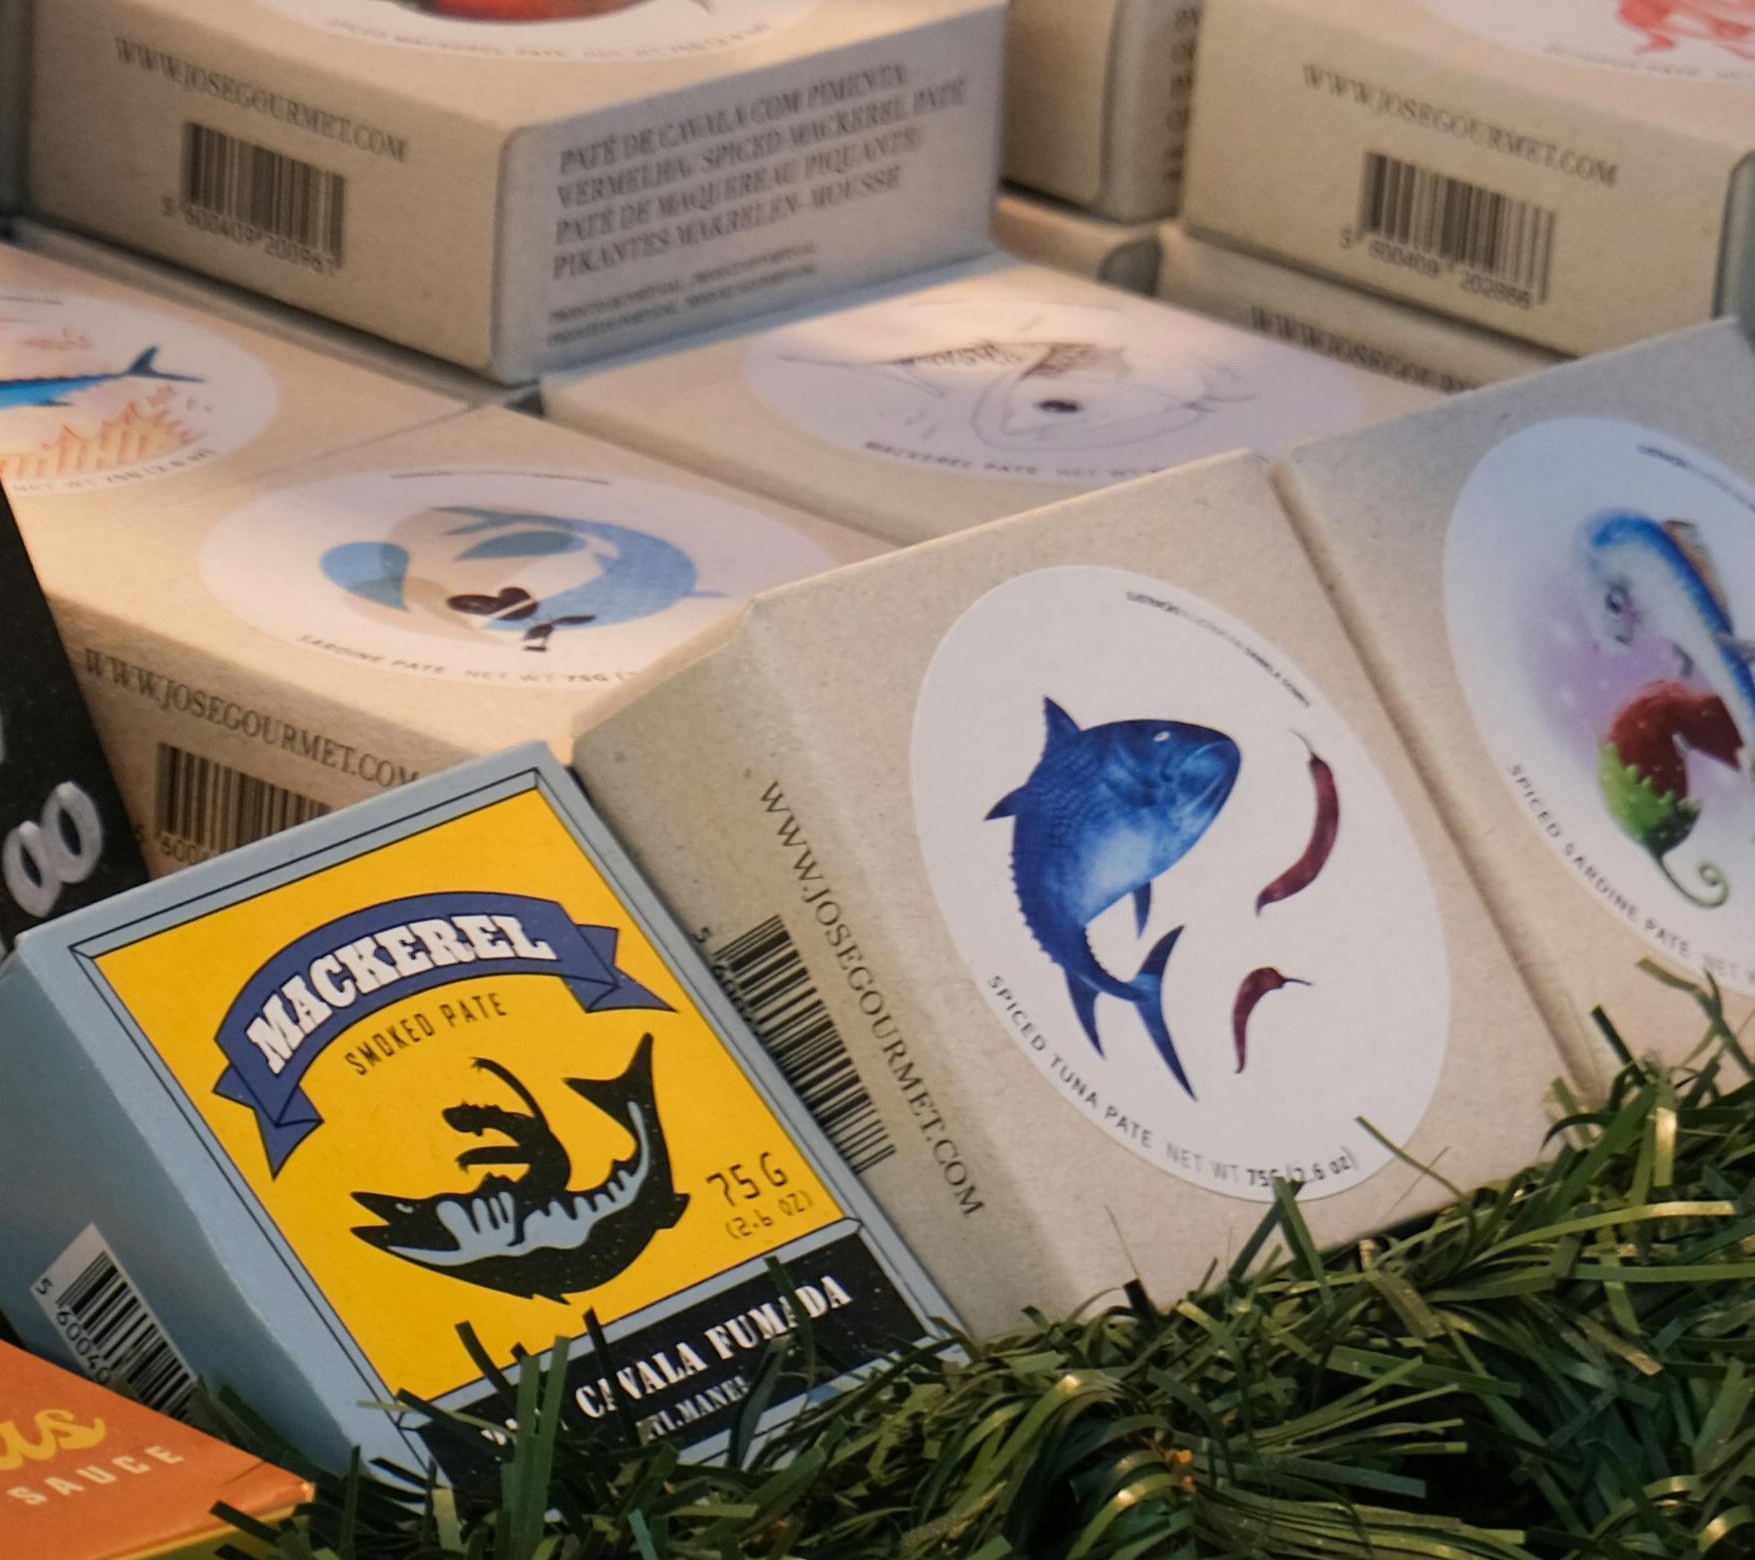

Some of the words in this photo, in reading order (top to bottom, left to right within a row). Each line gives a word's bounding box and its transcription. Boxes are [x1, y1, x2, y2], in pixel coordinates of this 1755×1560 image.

[113, 35, 409, 164] WWW.JOSEGOURMET.COM
[1301, 62, 1621, 188] WWW.JOSEGOURMET.COM
[82, 646, 421, 789] WWW.JOSEGOURMET.COM
[1510, 764, 1562, 839] SPICED
[245, 913, 561, 1076] MACKEREL
[691, 926, 713, 945] 5
[343, 1011, 436, 1077] SMOKED
[439, 991, 508, 1029] PATE
[758, 781, 985, 1219] WWW.JOSEGOURMET.COM
[986, 975, 1047, 1052] SPICED
[1049, 1052, 1099, 1110] TUNA
[1103, 1103, 1154, 1149] PATE
[1165, 1141, 1203, 1173] NET
[1209, 1159, 1239, 1182] WT
[35, 1278, 54, 1296] 5
[6, 1442, 186, 1507] SAUCE
